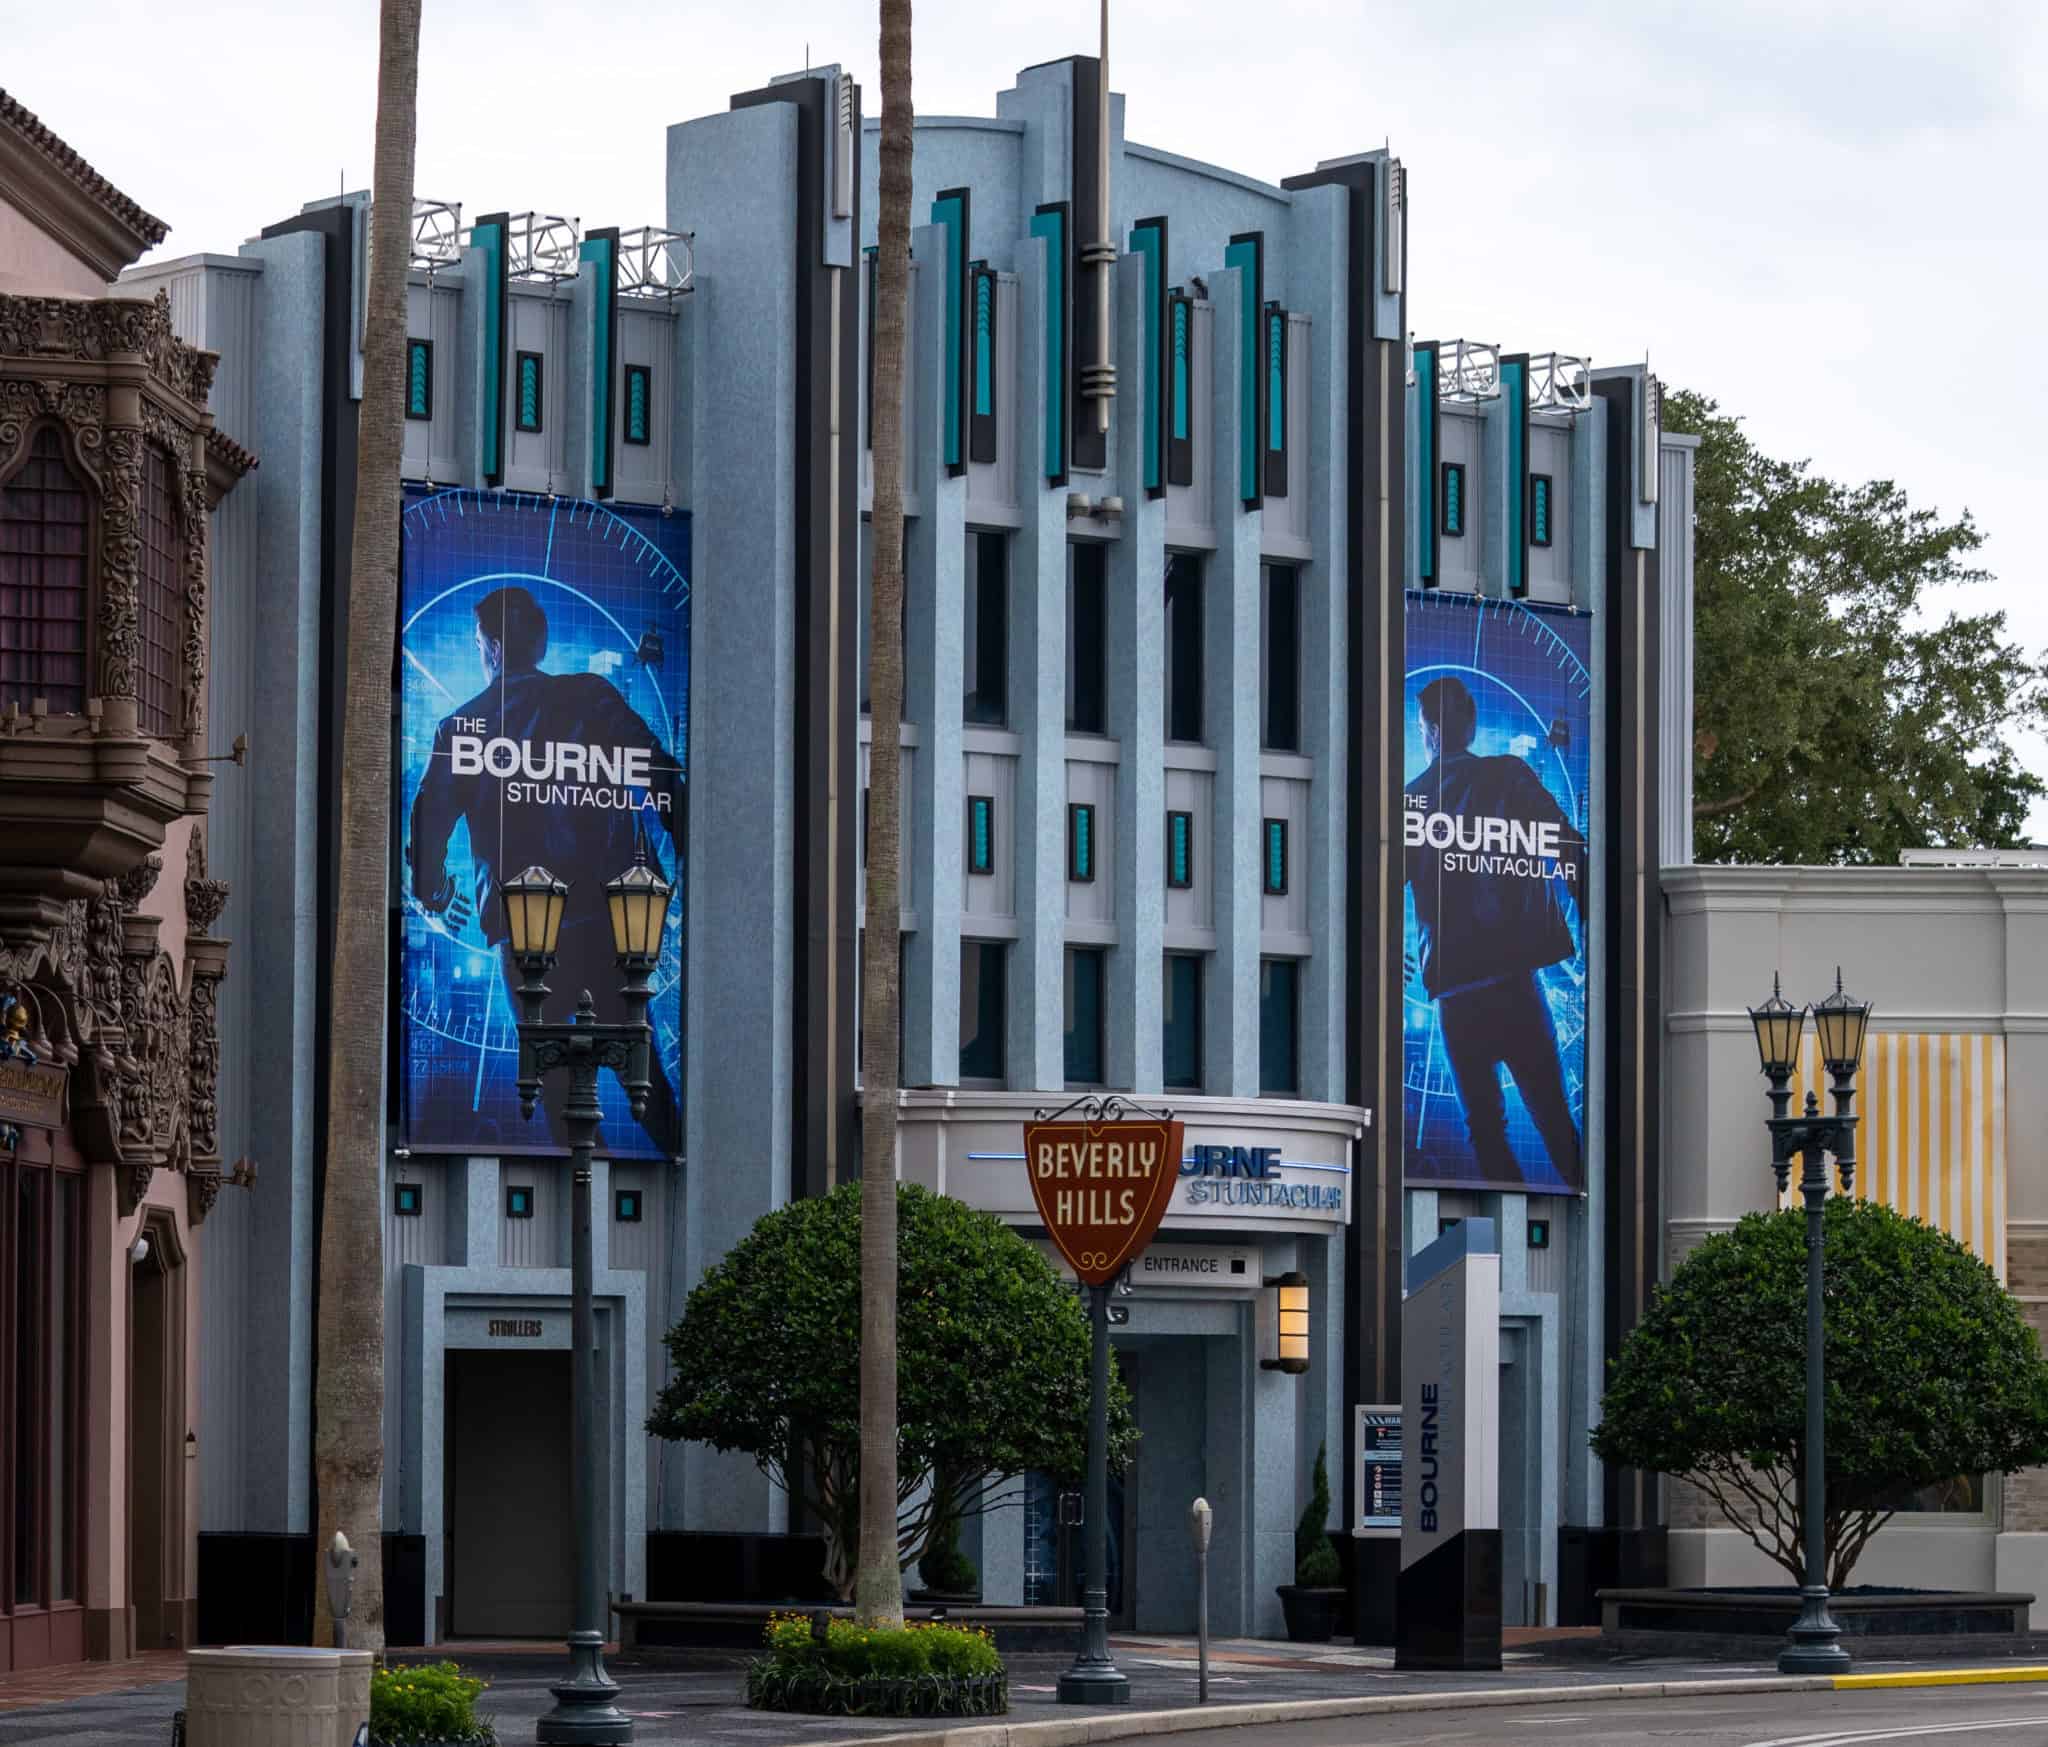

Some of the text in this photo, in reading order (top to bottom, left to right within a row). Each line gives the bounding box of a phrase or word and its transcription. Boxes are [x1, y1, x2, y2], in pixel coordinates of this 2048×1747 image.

[453, 716, 487, 733] THE
[451, 735, 651, 787] BOURNE
[507, 782, 672, 813] STUNTACULAR
[1403, 811, 1560, 858] BOURNE
[1443, 853, 1576, 880] STUNTACULAR
[1037, 1142, 1157, 1179] BEVERLY
[1056, 1189, 1136, 1226] HILLS
[1189, 1180, 1342, 1210] STUNTACULAR
[1144, 1256, 1219, 1273] ENTRANCE
[488, 1319, 543, 1337] STROLLERS
[1421, 1383, 1439, 1533] BOURNE
